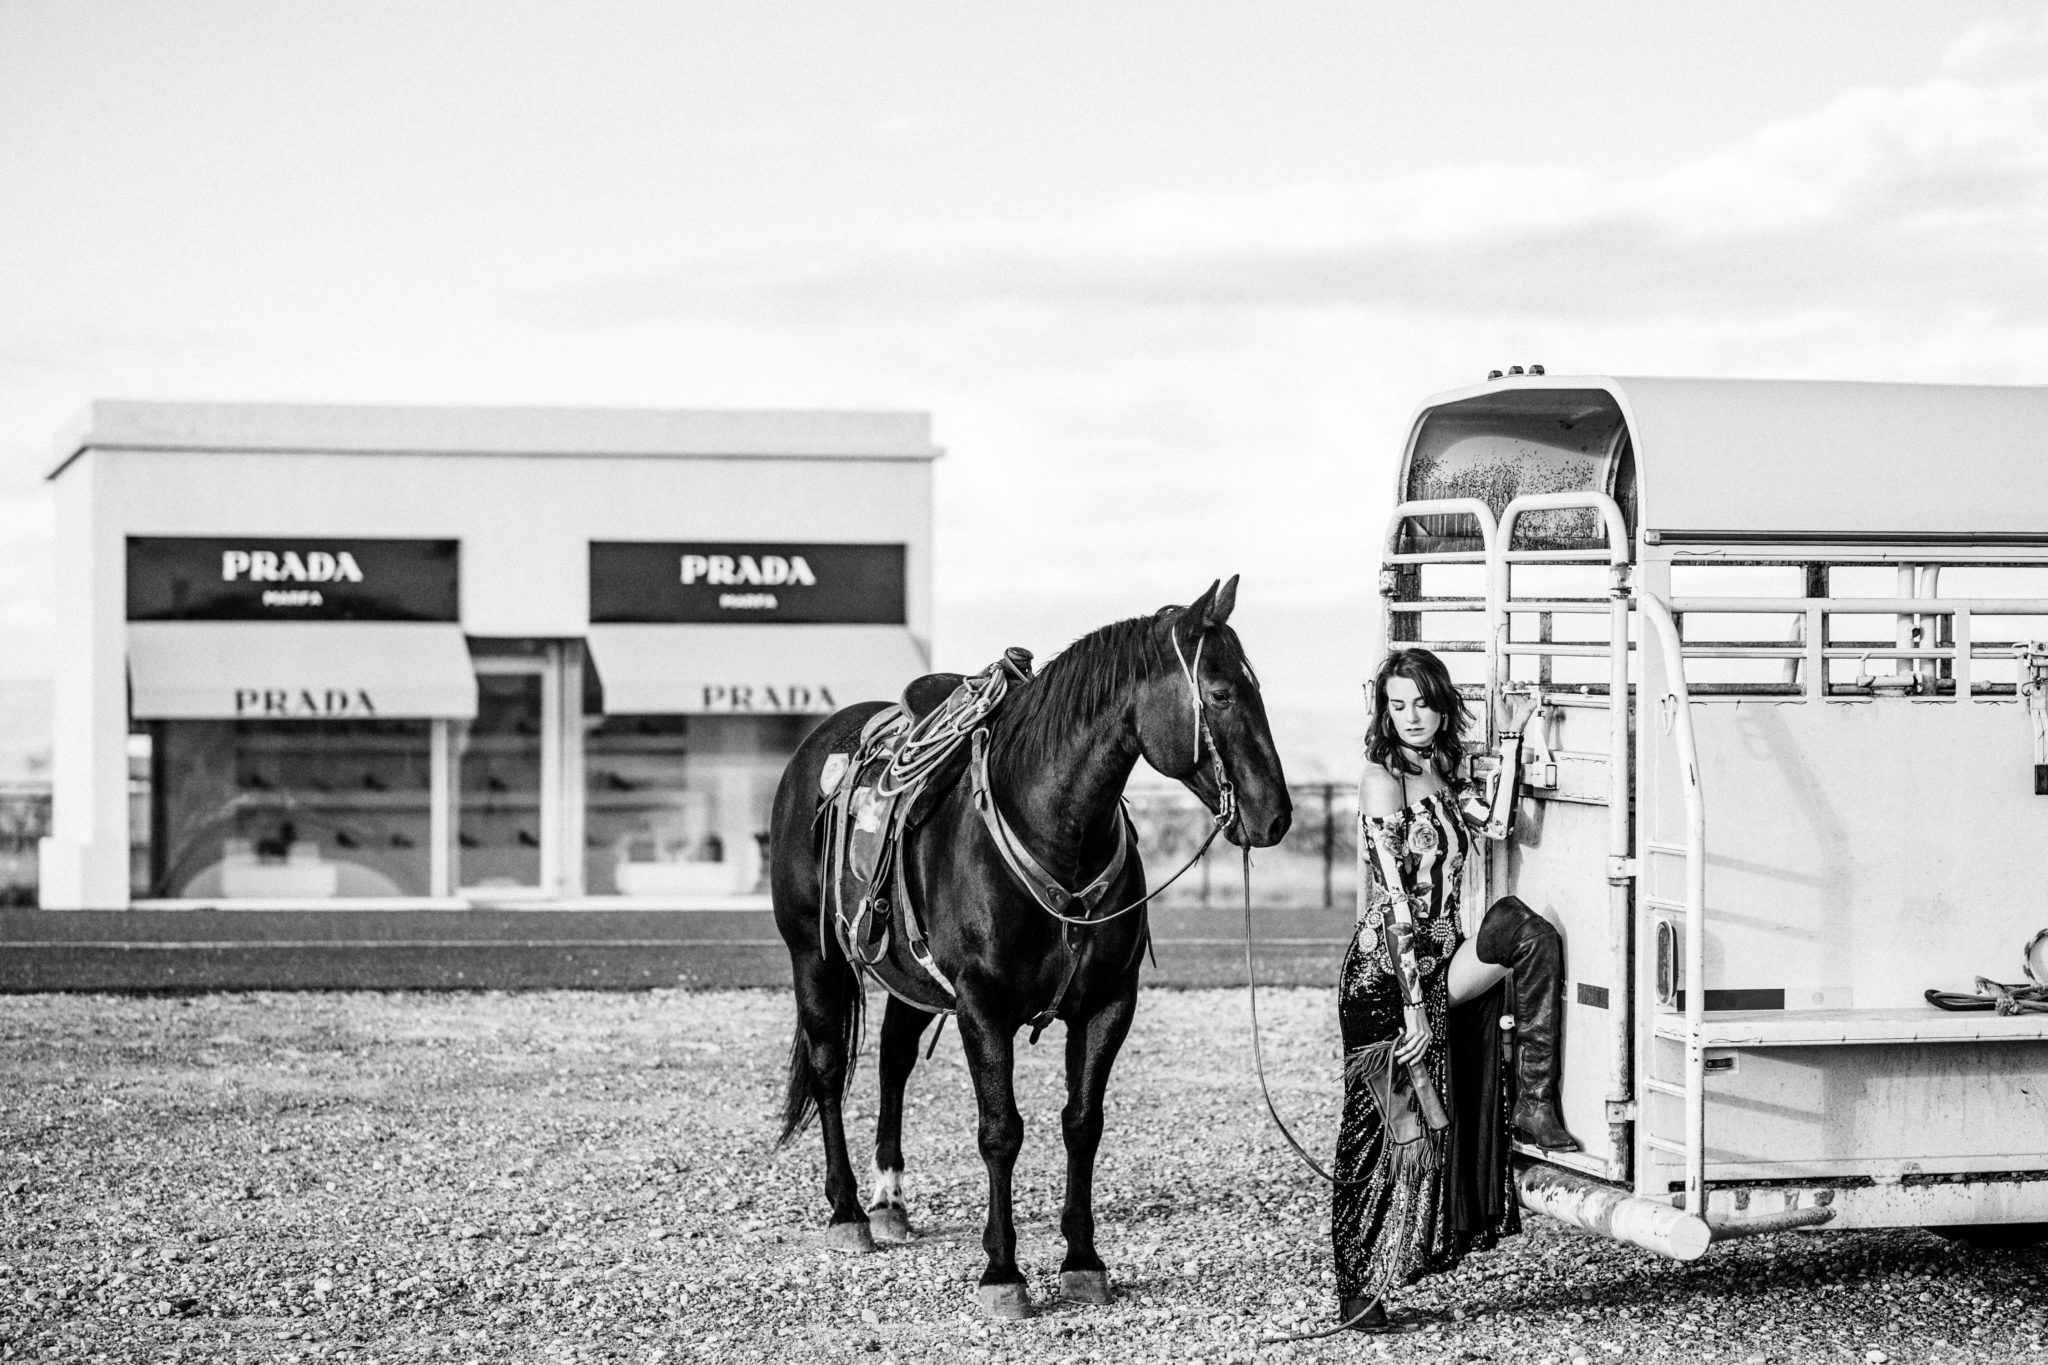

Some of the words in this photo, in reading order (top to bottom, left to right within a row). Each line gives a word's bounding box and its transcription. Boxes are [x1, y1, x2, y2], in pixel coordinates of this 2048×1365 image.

[222, 551, 363, 582] PRADA
[680, 555, 816, 585] PRADA
[235, 688, 378, 714] PRADA
[702, 686, 837, 711] PRADA
